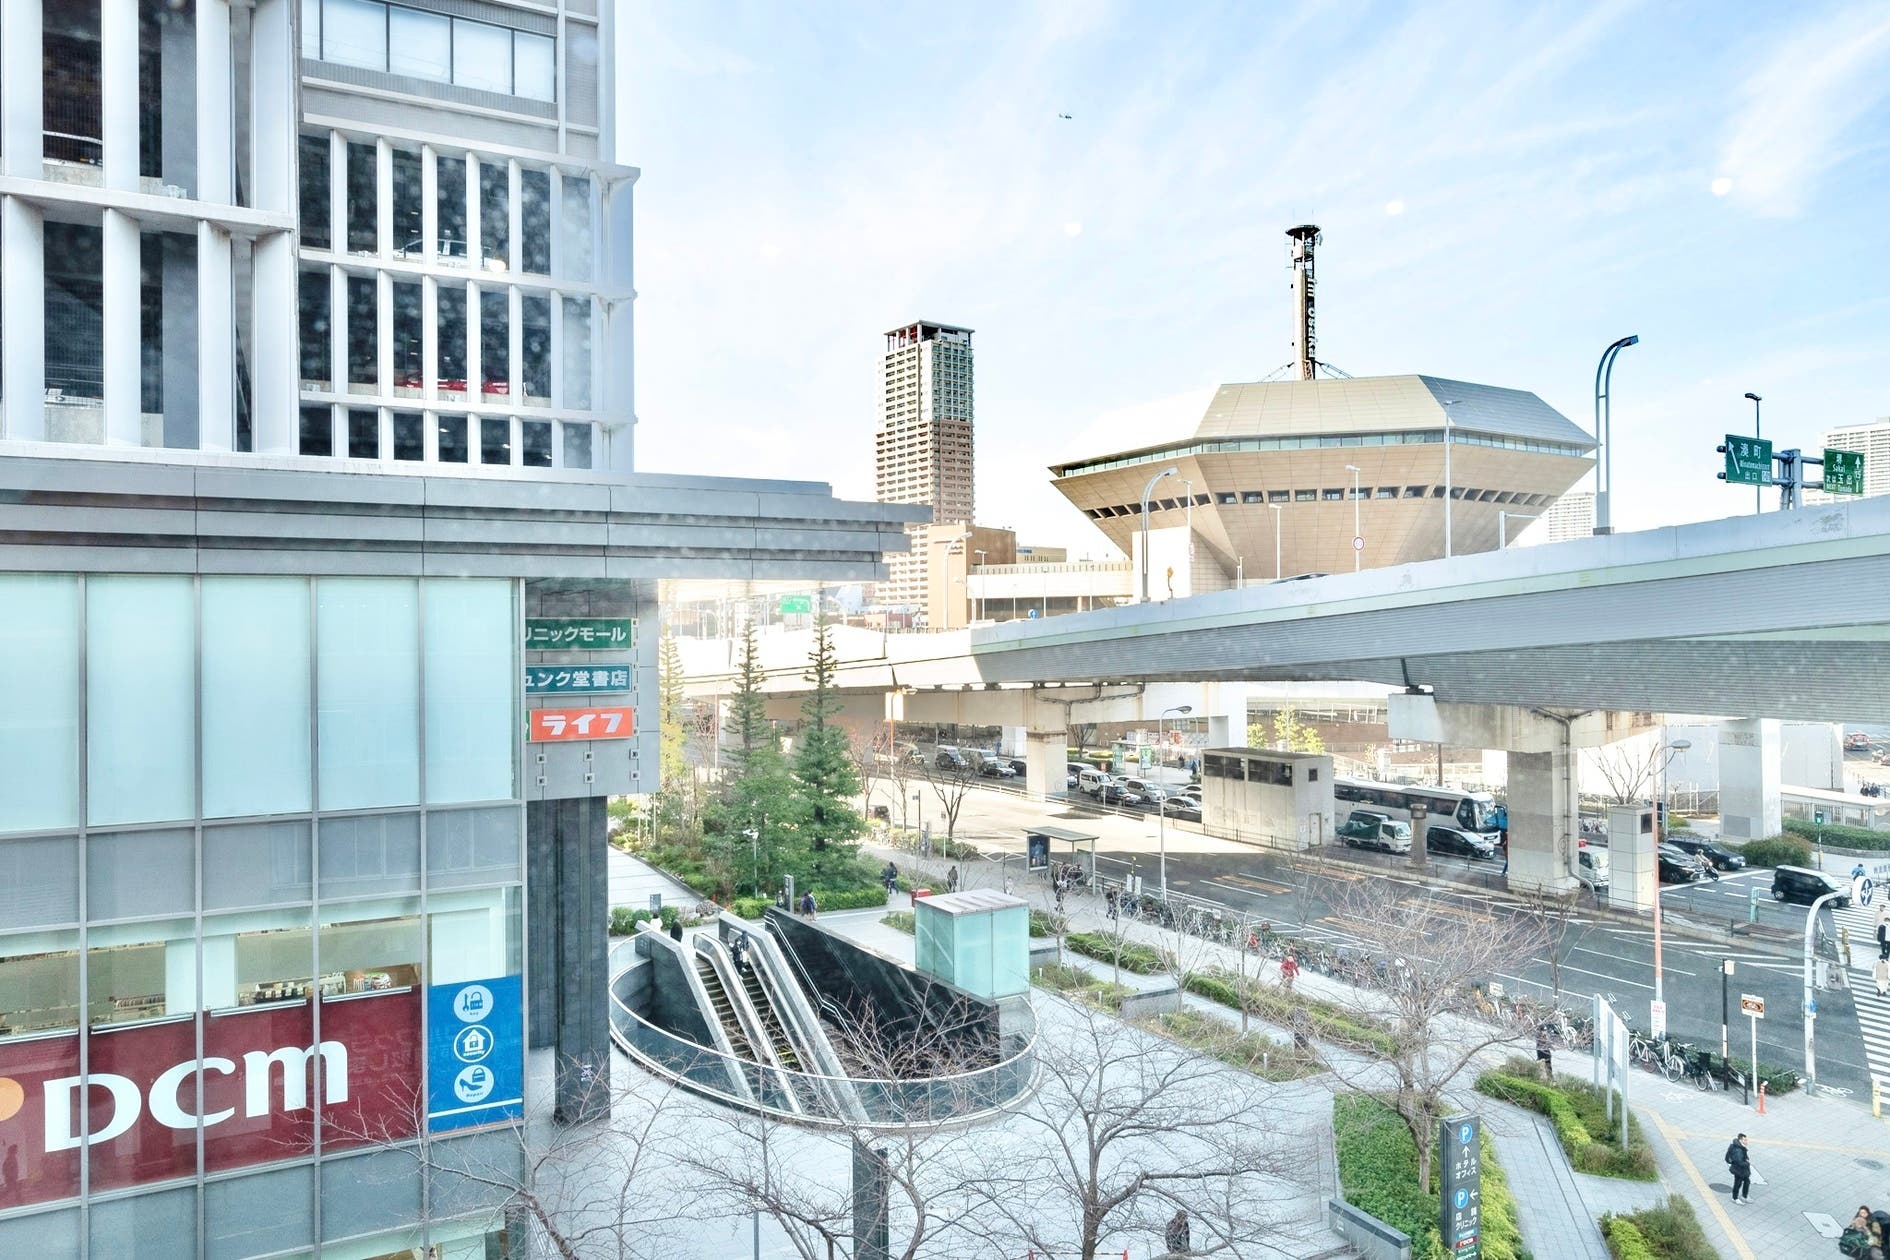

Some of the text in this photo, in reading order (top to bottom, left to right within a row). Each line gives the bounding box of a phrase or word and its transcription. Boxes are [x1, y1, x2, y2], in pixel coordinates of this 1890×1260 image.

[542, 713, 623, 735] ライフ
[1456, 1158, 1477, 1170] ホテル
[1456, 1167, 1477, 1179] オフィス
[1456, 1216, 1477, 1230] クリニック
